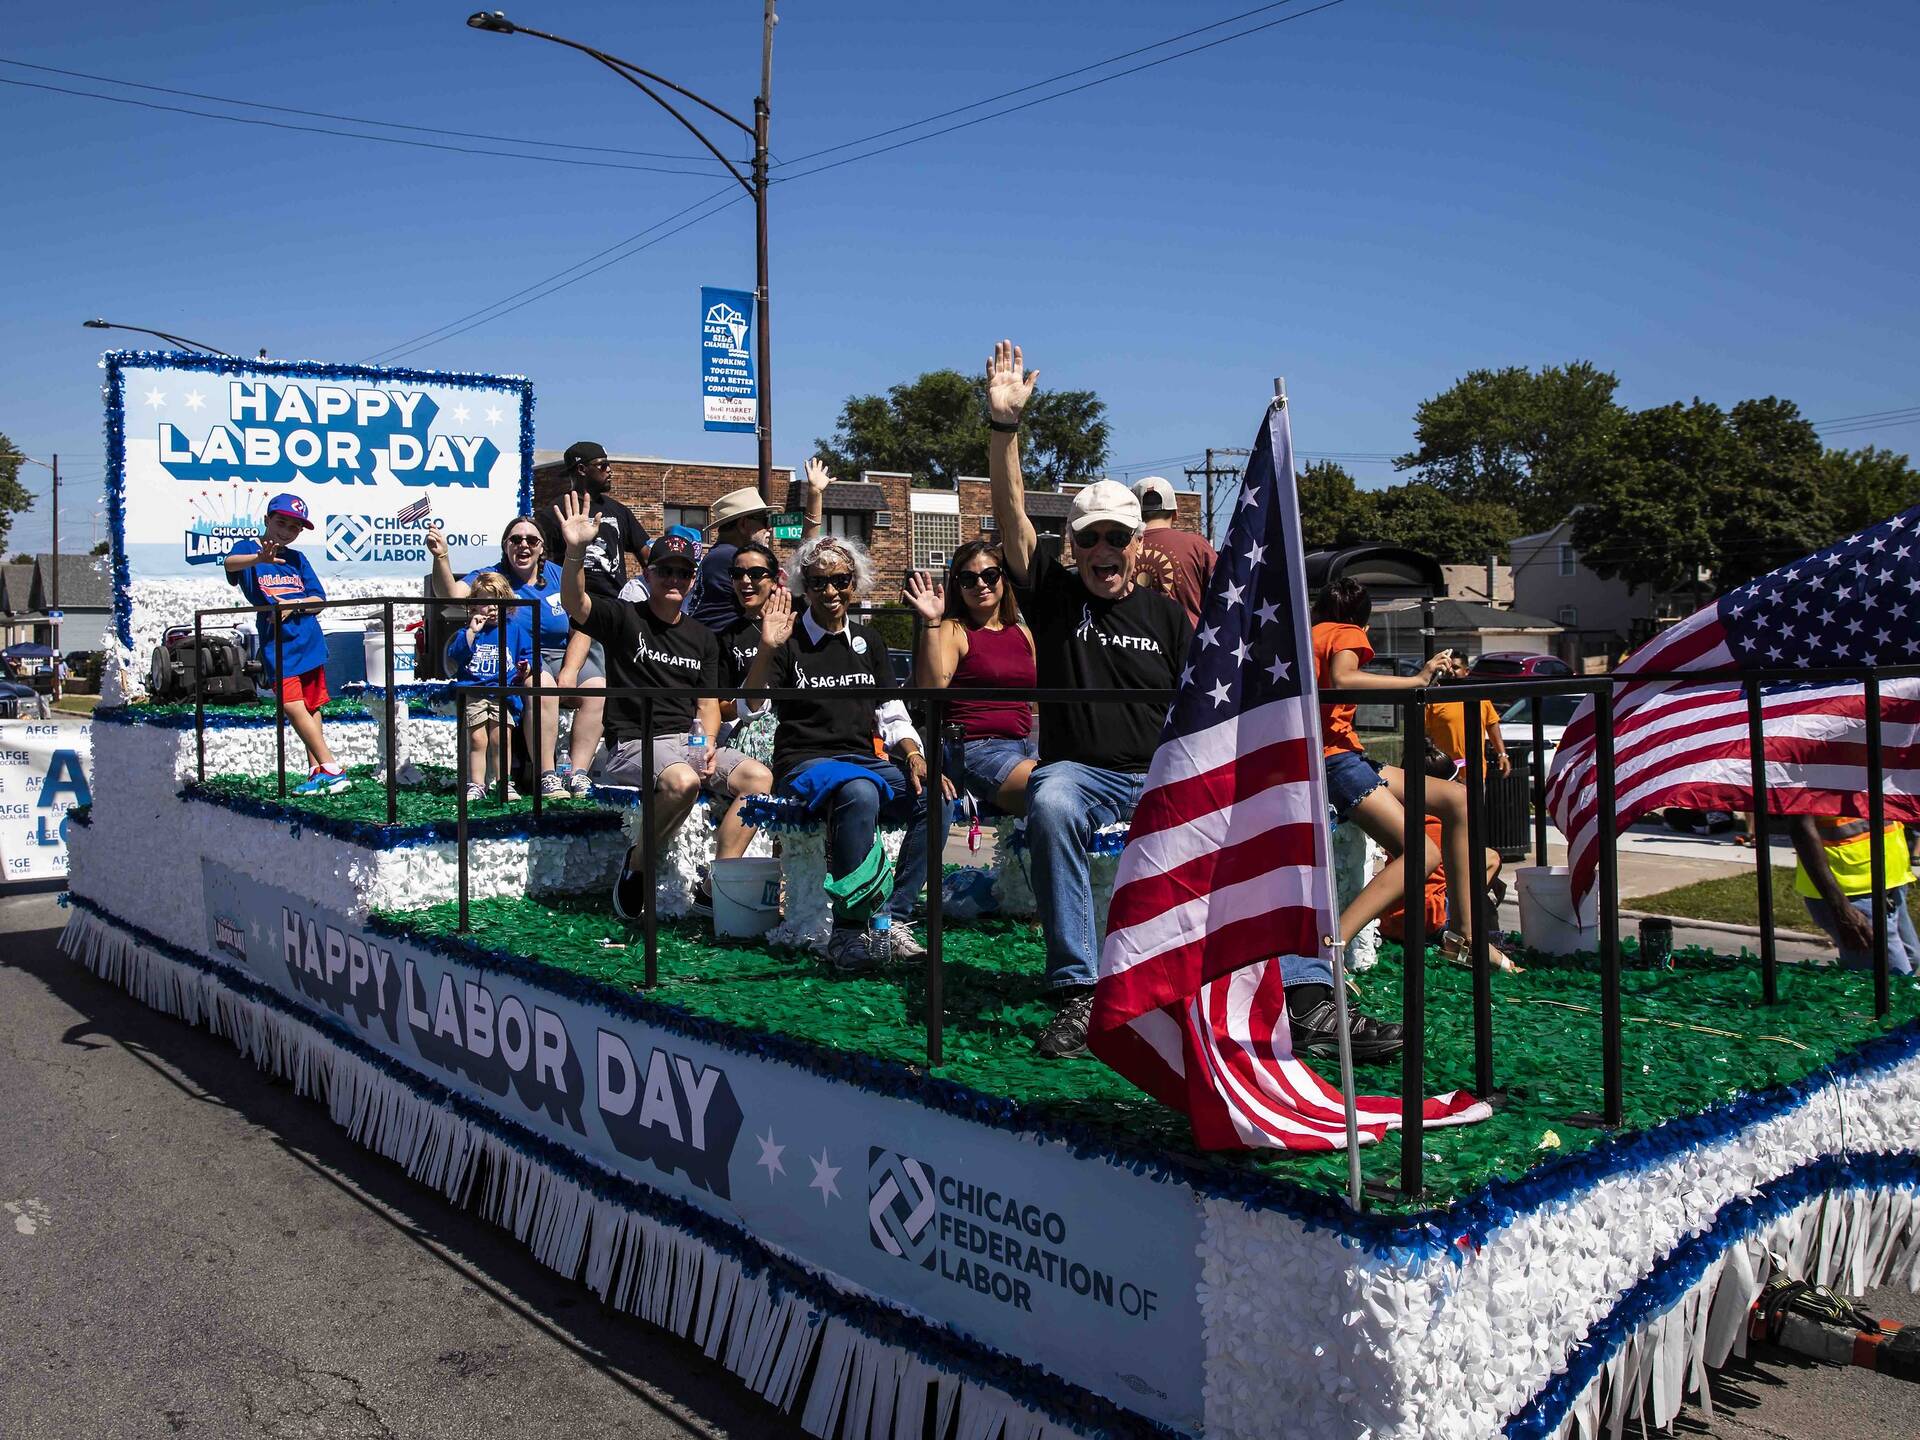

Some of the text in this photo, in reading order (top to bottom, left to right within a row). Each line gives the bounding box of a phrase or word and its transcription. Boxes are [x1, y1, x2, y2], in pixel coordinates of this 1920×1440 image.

[704, 325, 726, 334] EAST
[713, 335, 733, 343] SIDE
[704, 341, 735, 349] CHAMBER
[711, 357, 746, 366] WORKING
[710, 367, 747, 376] TOGETHER
[704, 375, 719, 383] FOR
[727, 377, 753, 385] BETTER
[707, 385, 751, 394] COMMUNITY
[229, 381, 425, 428] HAPPY
[159, 423, 485, 473] LABOR DAY
[212, 527, 259, 537] CHICAGO
[187, 533, 244, 557] LABO
[374, 533, 488, 546] FEDERON OF
[374, 550, 426, 562] LABOR
[26, 725, 58, 735] AFGE
[282, 906, 721, 1151] HAPPY LABOR DAY
[939, 1176, 1066, 1245] CHICAGO
[940, 1213, 1157, 1321] FEDERATION OF
[941, 1248, 1033, 1313] LABOR
